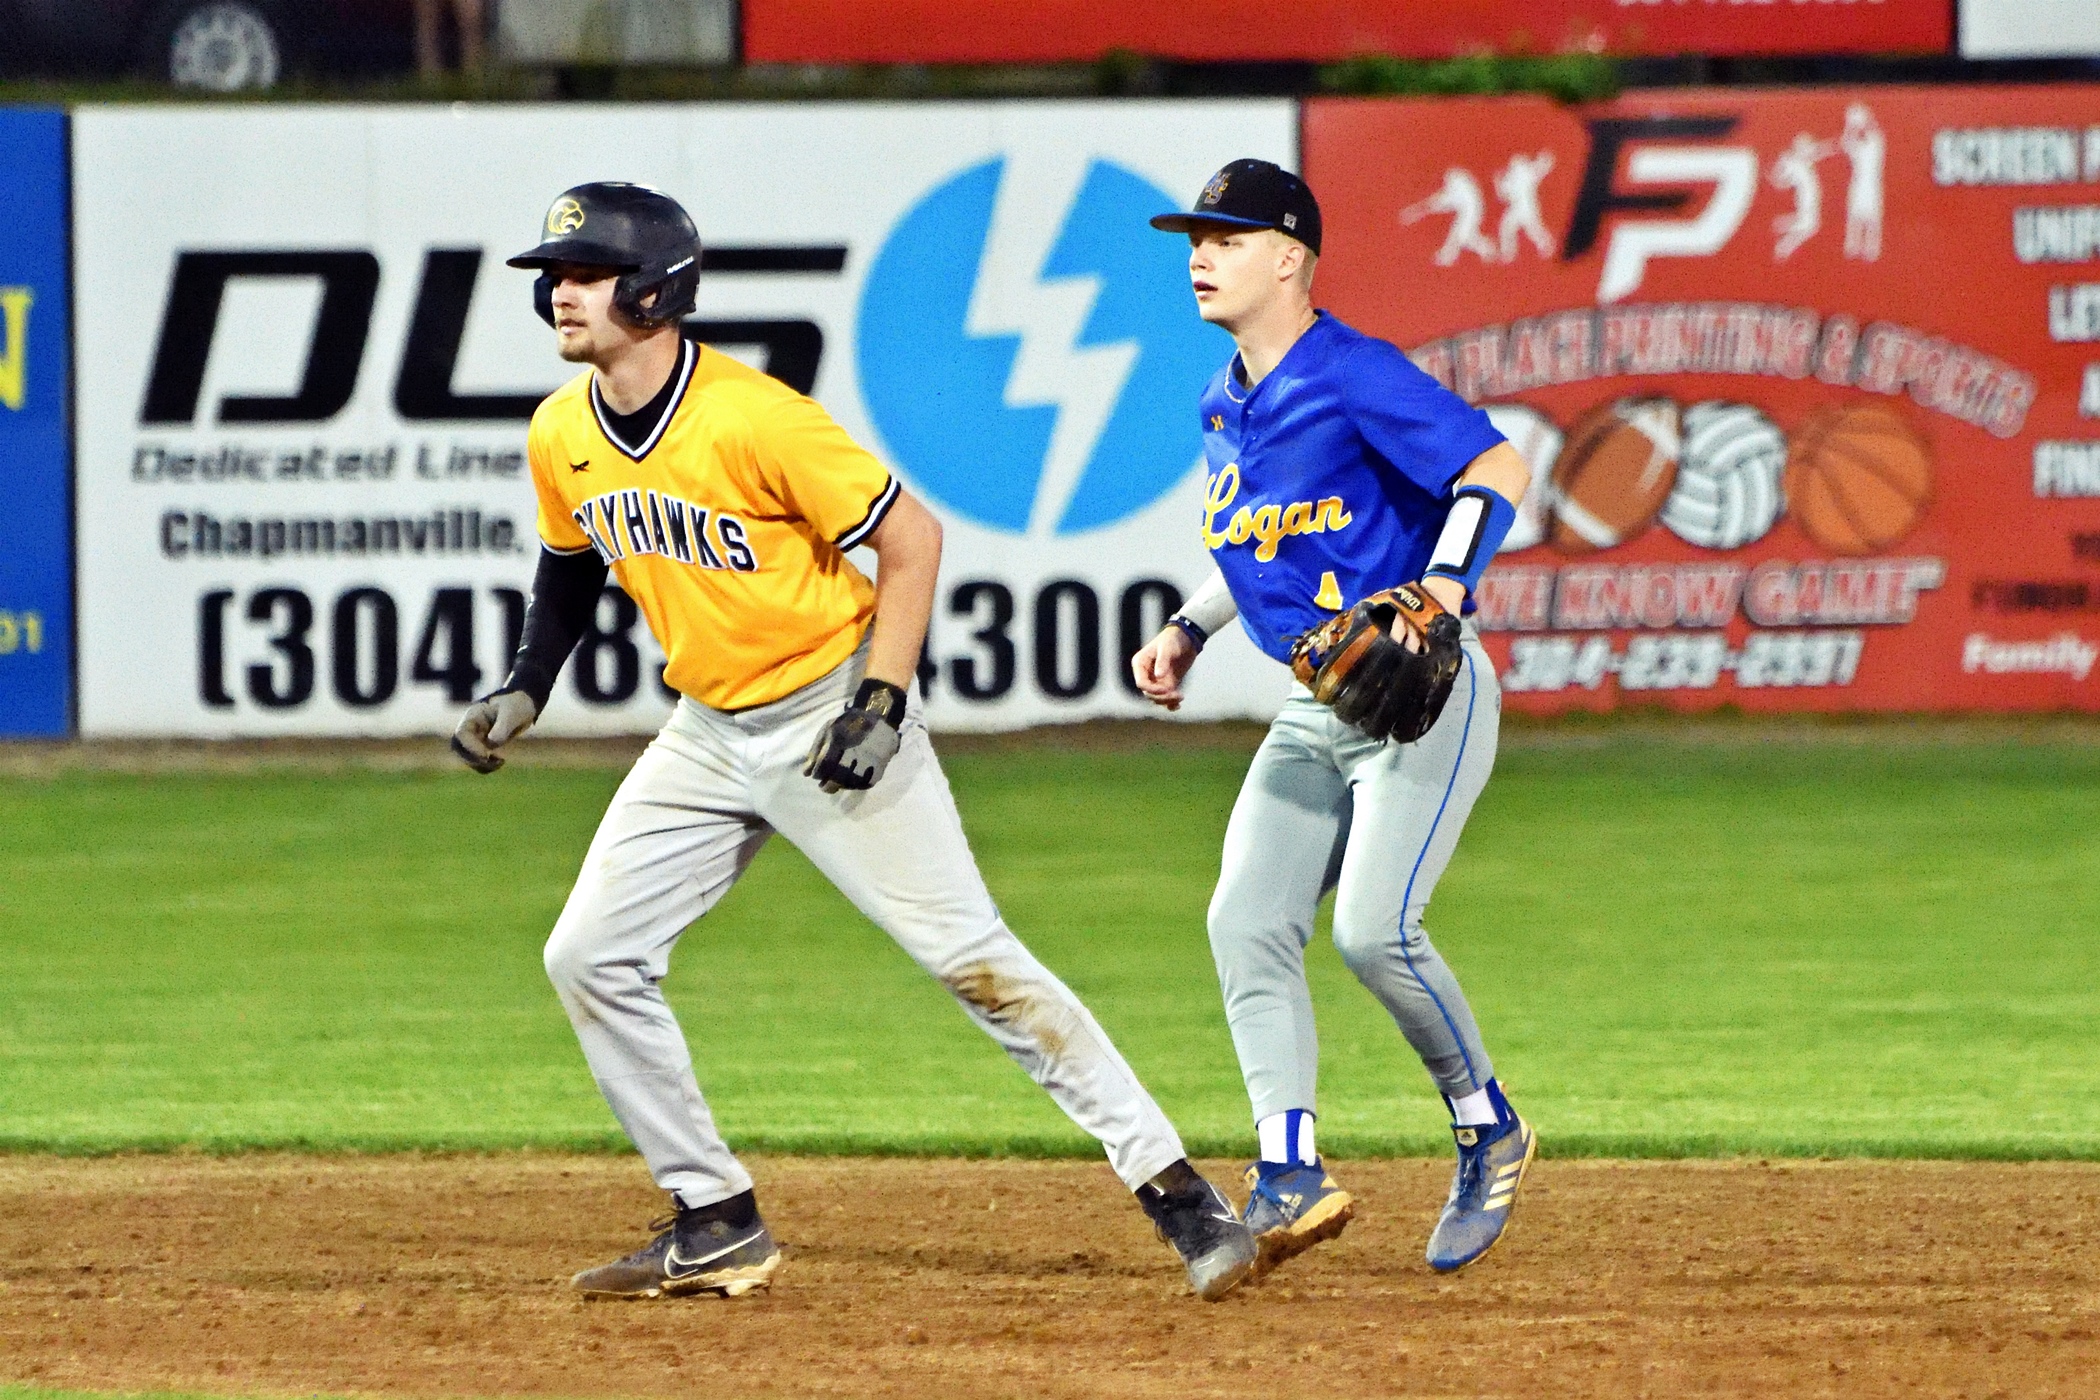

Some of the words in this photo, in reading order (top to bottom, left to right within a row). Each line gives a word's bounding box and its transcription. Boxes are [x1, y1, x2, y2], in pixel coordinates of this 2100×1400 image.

[1930, 126, 2079, 186] SCREEN
[131, 444, 400, 484] Dedicated
[1200, 463, 1353, 563] Logan
[1962, 630, 2099, 682] Family
